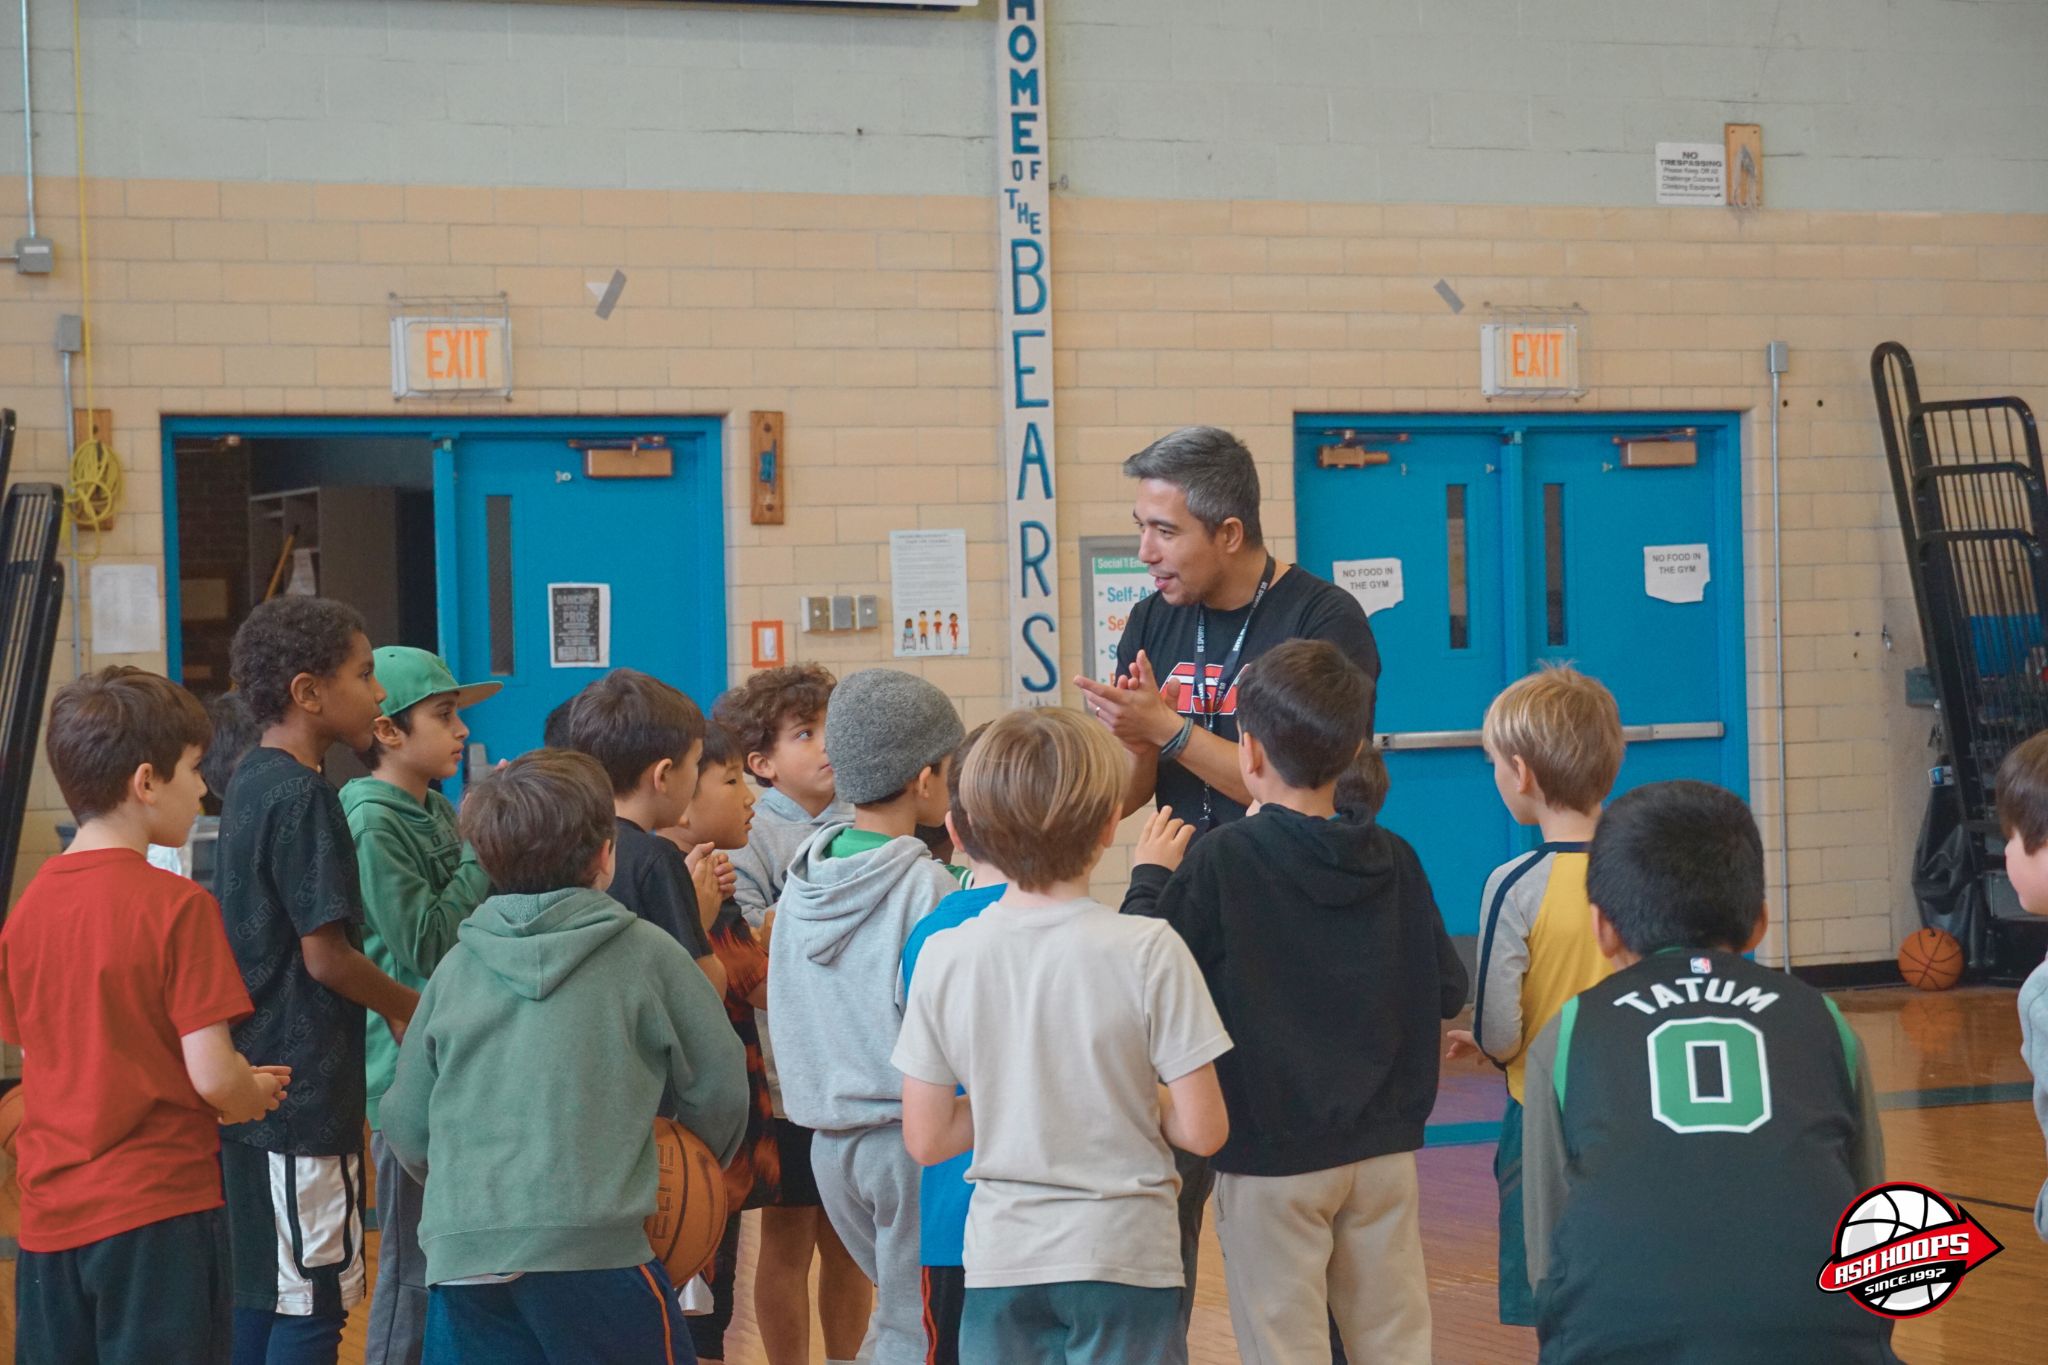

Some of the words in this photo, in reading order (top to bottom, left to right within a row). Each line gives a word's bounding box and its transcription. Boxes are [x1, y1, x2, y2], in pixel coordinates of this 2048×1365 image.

[1682, 151, 1698, 159] NO
[1660, 159, 1722, 167] TRESPASSING
[1012, 160, 1041, 181] OF
[1004, 188, 1041, 235] THE
[426, 329, 490, 378] EXIT
[1511, 333, 1564, 377] EXIT
[1011, 238, 1058, 693] BEARS
[1652, 554, 1665, 562] NO
[1667, 553, 1691, 561] FOOD
[1693, 552, 1701, 560] IN
[1098, 558, 1122, 569] Social
[1343, 569, 1356, 577] NO
[1358, 568, 1383, 577] FOOD
[1659, 566, 1675, 574] THE
[1677, 565, 1696, 574] GYM
[1350, 582, 1367, 590] THE
[1369, 580, 1389, 589] GYM
[563, 611, 589, 622] PROS
[1613, 977, 1780, 1015] TATUM
[1646, 1016, 1773, 1134] 0
